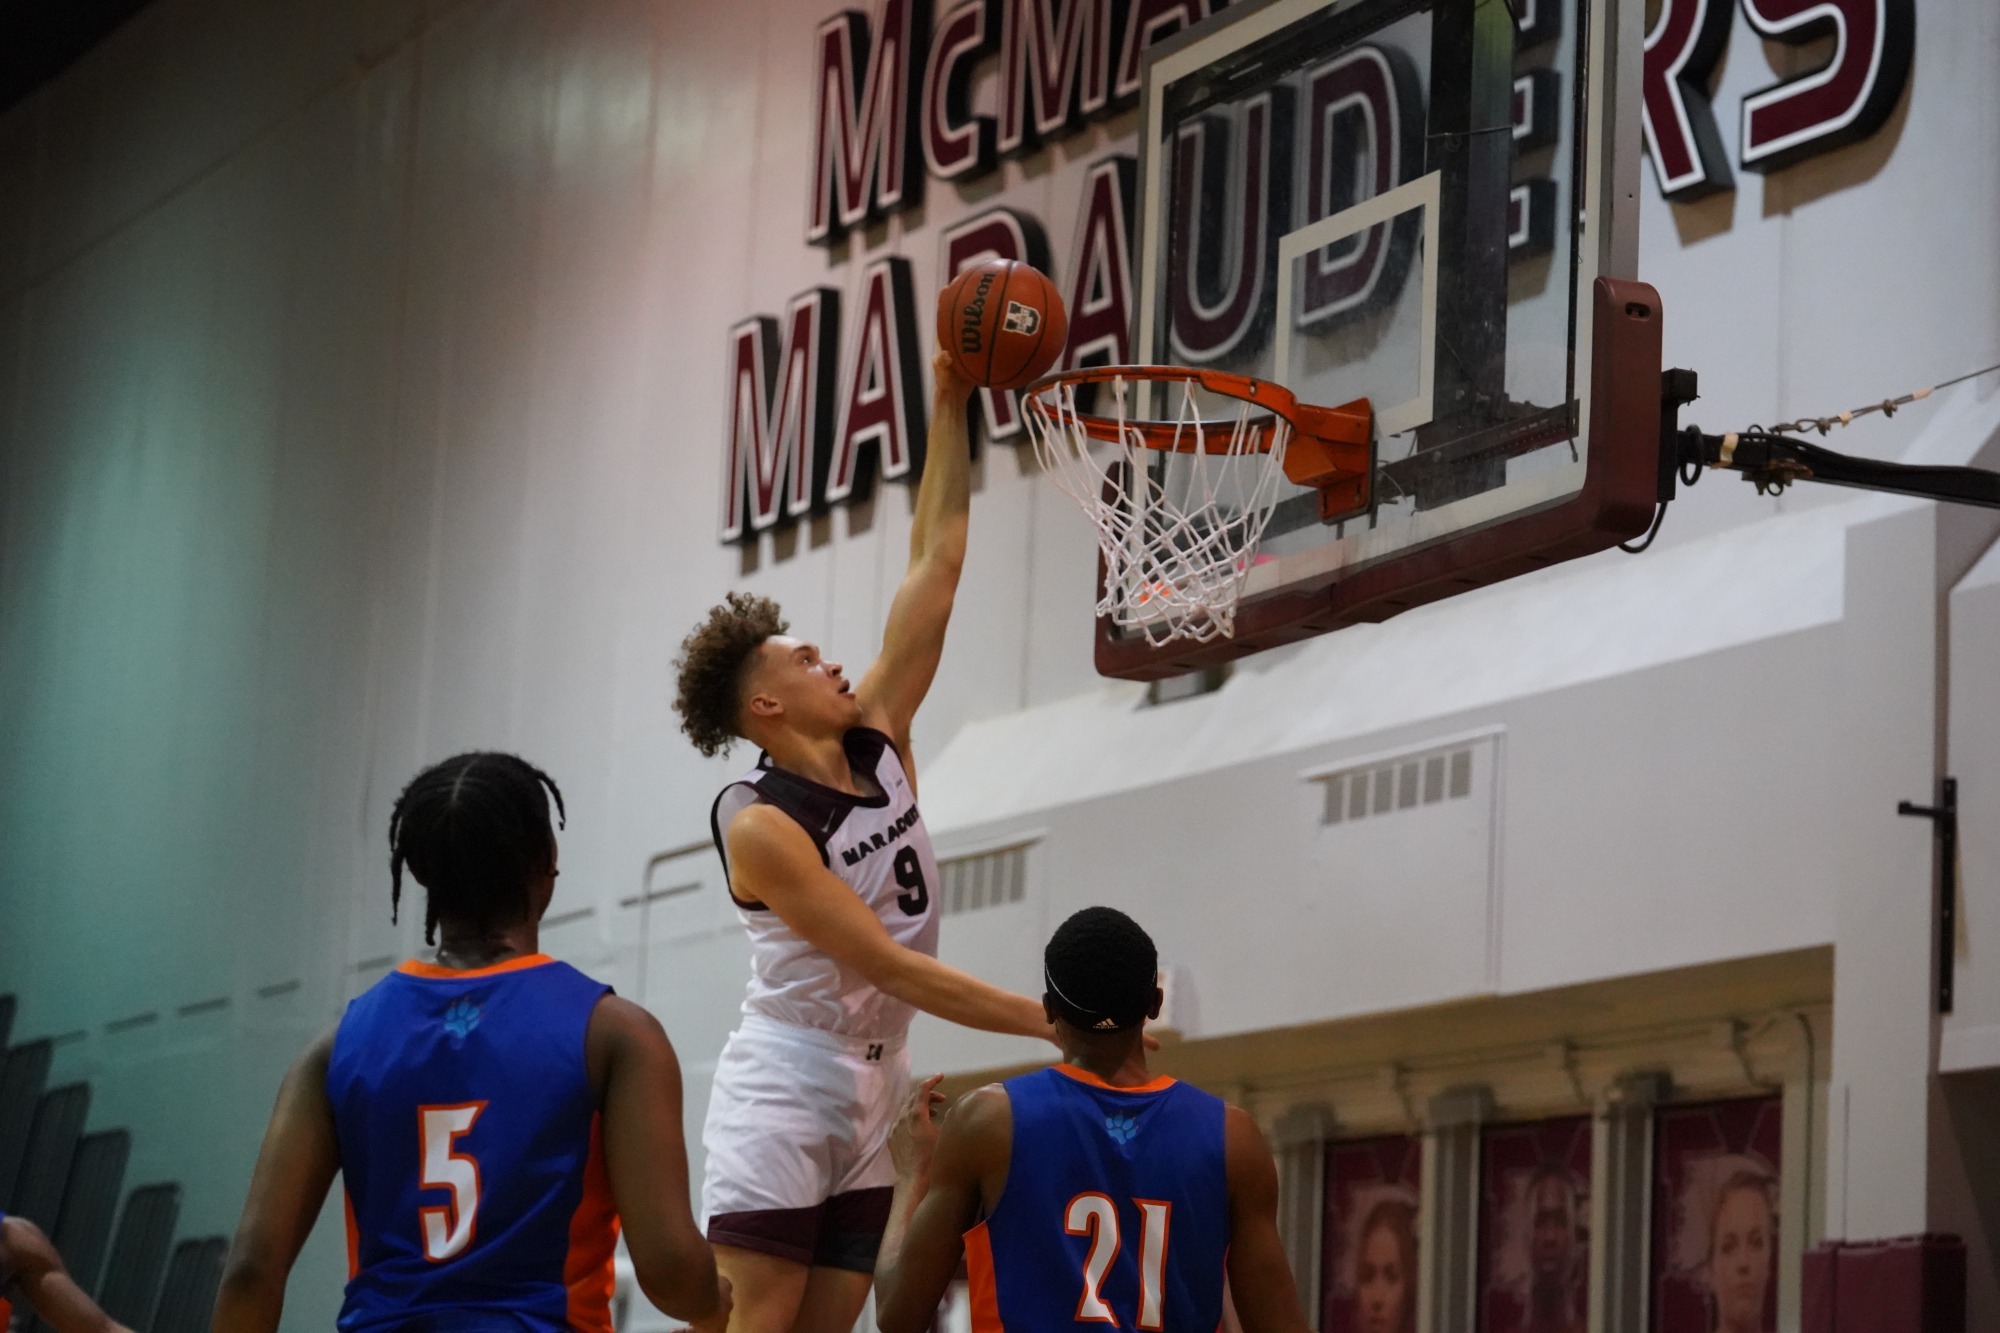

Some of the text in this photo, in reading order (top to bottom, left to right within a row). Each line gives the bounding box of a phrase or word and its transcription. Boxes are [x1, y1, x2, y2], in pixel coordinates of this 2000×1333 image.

[963, 273, 996, 352] Wilson
[893, 845, 929, 917] 9
[417, 1100, 488, 1263] 5
[1064, 1191, 1172, 1332] 21
